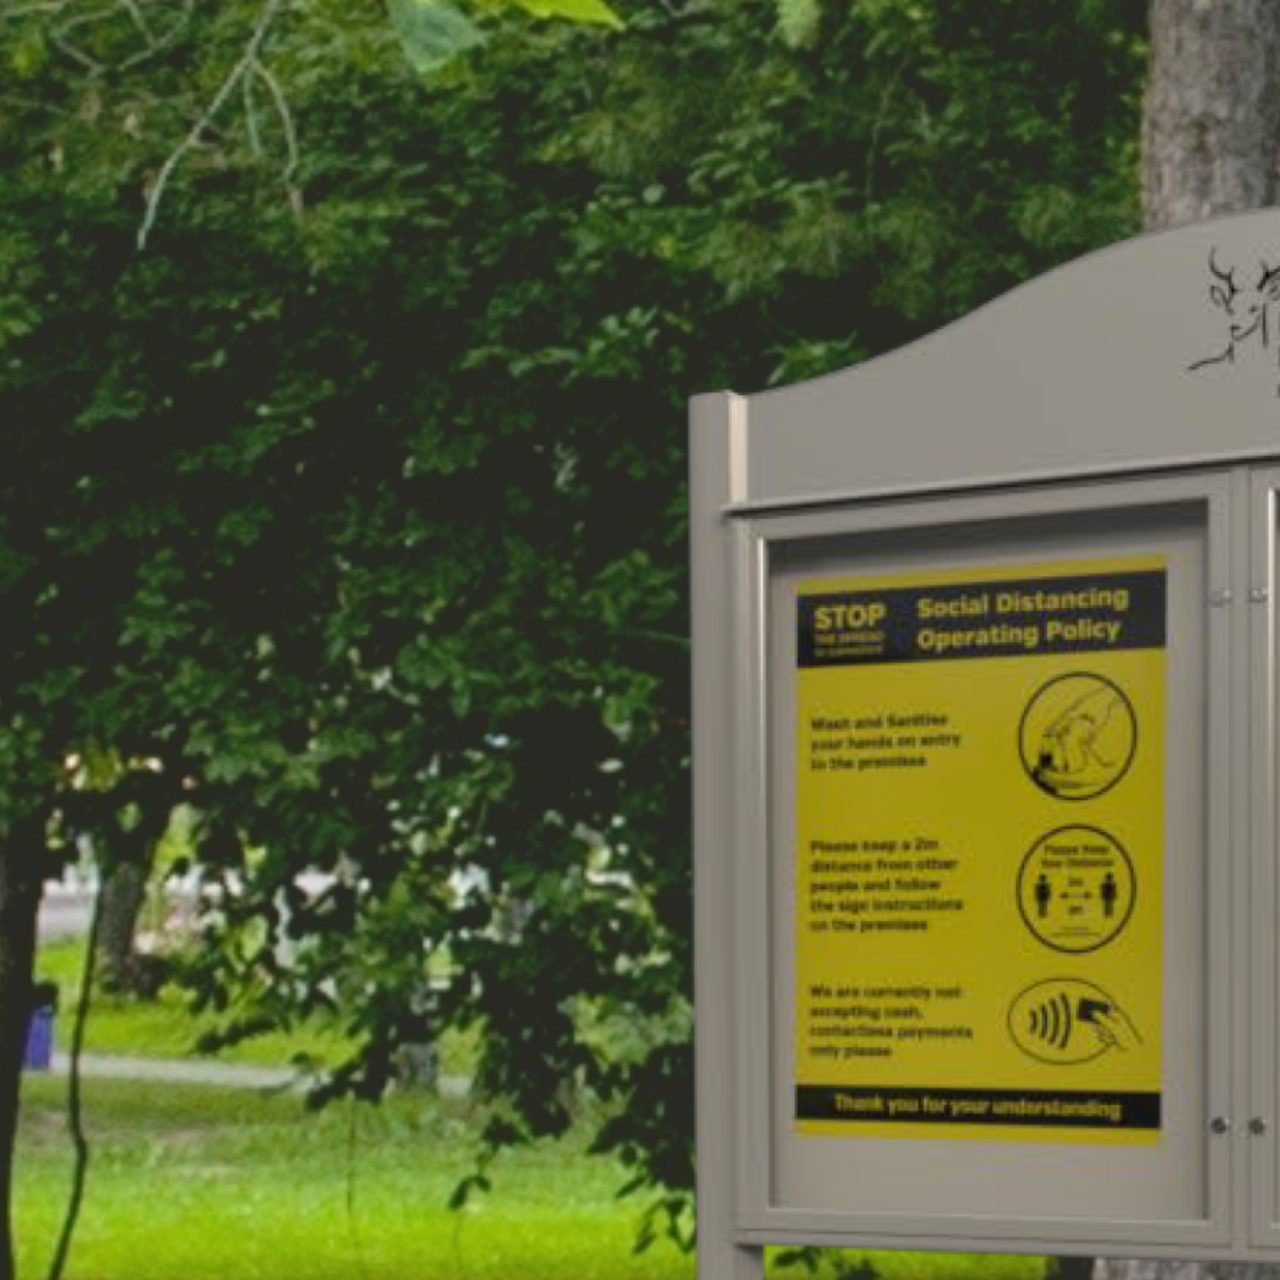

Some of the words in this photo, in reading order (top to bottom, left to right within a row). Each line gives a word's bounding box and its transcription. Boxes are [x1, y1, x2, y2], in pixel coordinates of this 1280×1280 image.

[917, 593, 988, 618] Social
[997, 587, 1129, 612] Distancing
[814, 603, 887, 630] STOP
[917, 622, 1038, 651] Operating
[1046, 618, 1121, 642] Policy
[855, 715, 882, 729] and
[848, 736, 893, 750] hands
[897, 737, 916, 748] on
[921, 734, 960, 748] entry
[829, 756, 853, 770] the
[810, 840, 858, 852] Please
[862, 840, 898, 854] keep
[811, 859, 872, 873] distance
[877, 858, 913, 871] from
[916, 859, 958, 871] other
[810, 880, 858, 895] people
[864, 878, 890, 892] and
[895, 878, 941, 891] follow
[834, 1092, 882, 1112] Thank
[888, 1097, 918, 1117] you
[923, 1095, 948, 1114] for
[950, 1098, 992, 1118] your
[992, 1098, 1121, 1123] understanding
